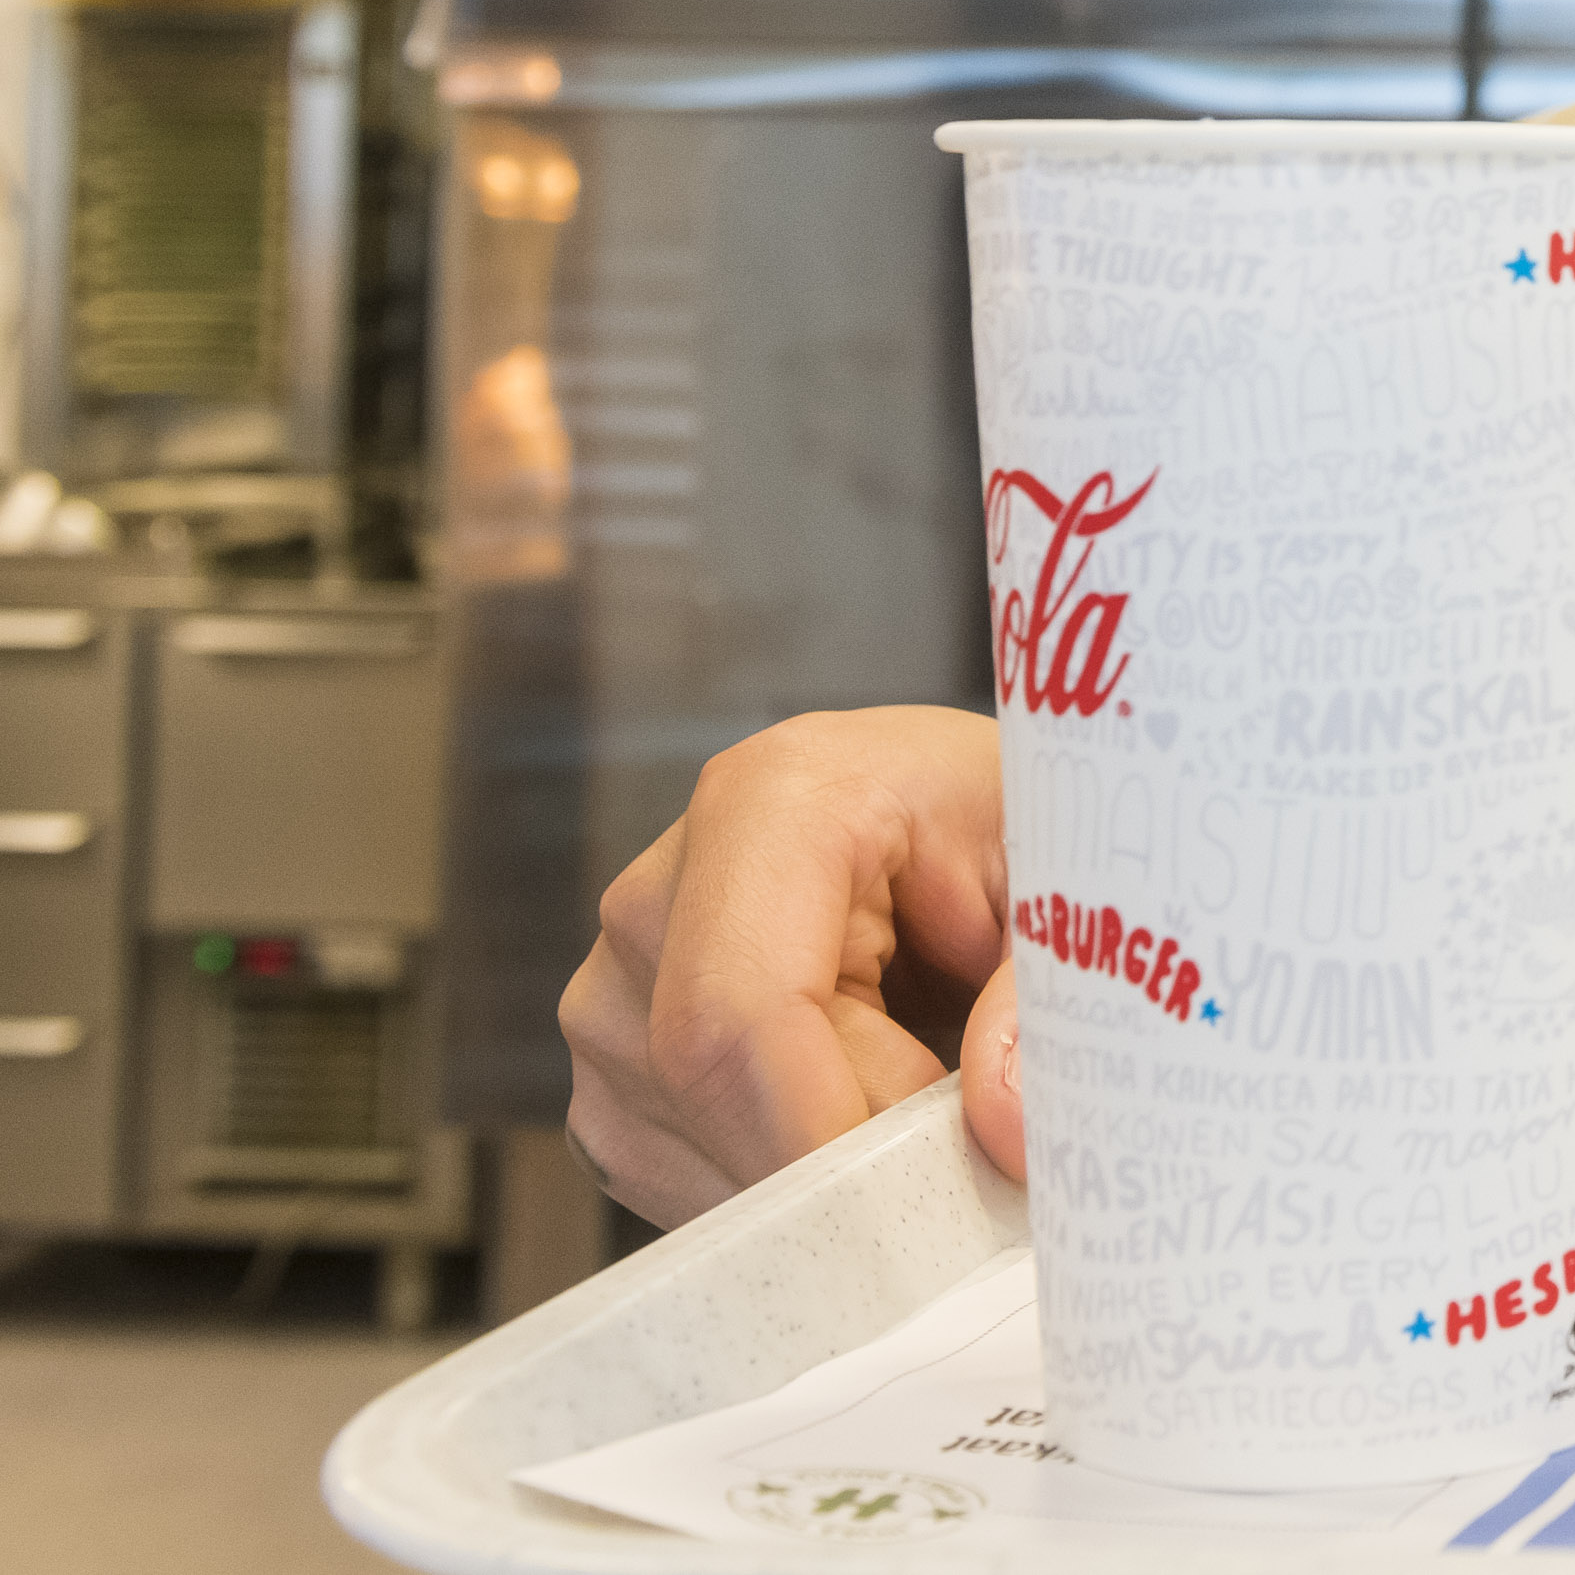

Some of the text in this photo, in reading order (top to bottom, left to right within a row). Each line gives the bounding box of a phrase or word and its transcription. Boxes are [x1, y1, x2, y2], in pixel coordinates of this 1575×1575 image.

[1049, 234, 1276, 300] THOUGHT.
[1015, 891, 1202, 1023] ESBURGER
[1151, 1058, 1317, 1113] KAIKKEA
[1335, 1068, 1455, 1118] PAITSI
[1184, 1269, 1245, 1309] UP
[1267, 1246, 1450, 1306] EVERY
